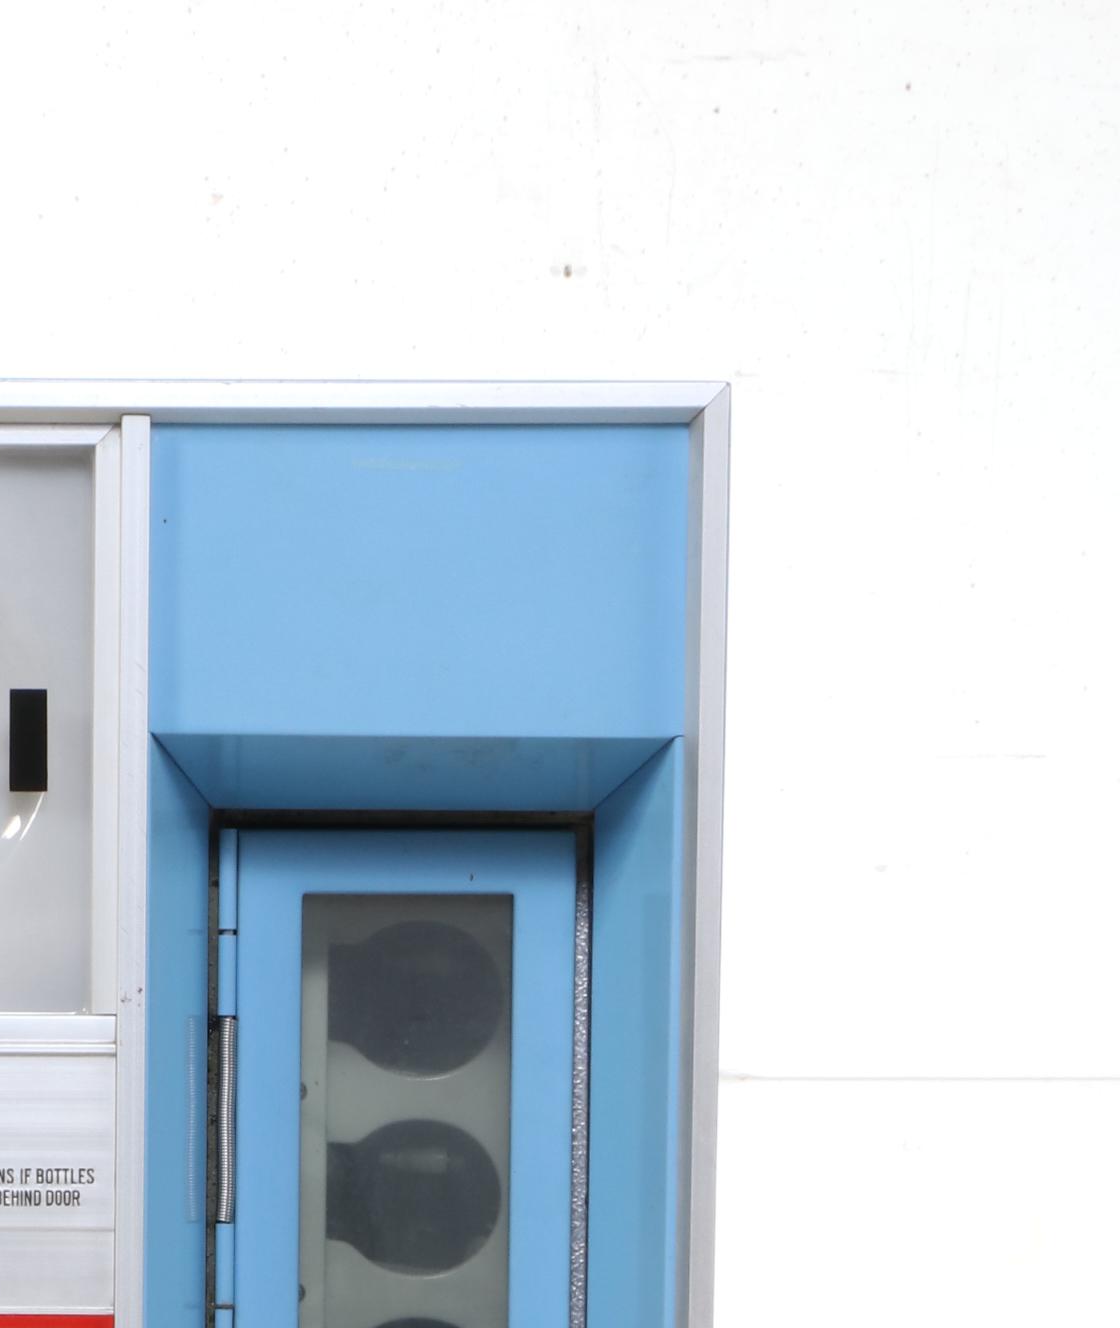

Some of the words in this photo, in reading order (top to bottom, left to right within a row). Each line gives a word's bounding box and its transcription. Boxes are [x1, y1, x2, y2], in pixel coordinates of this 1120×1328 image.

[20, 1168, 32, 1184] IF
[36, 1168, 95, 1185] BOTTLES
[45, 1189, 81, 1206] DOOR
